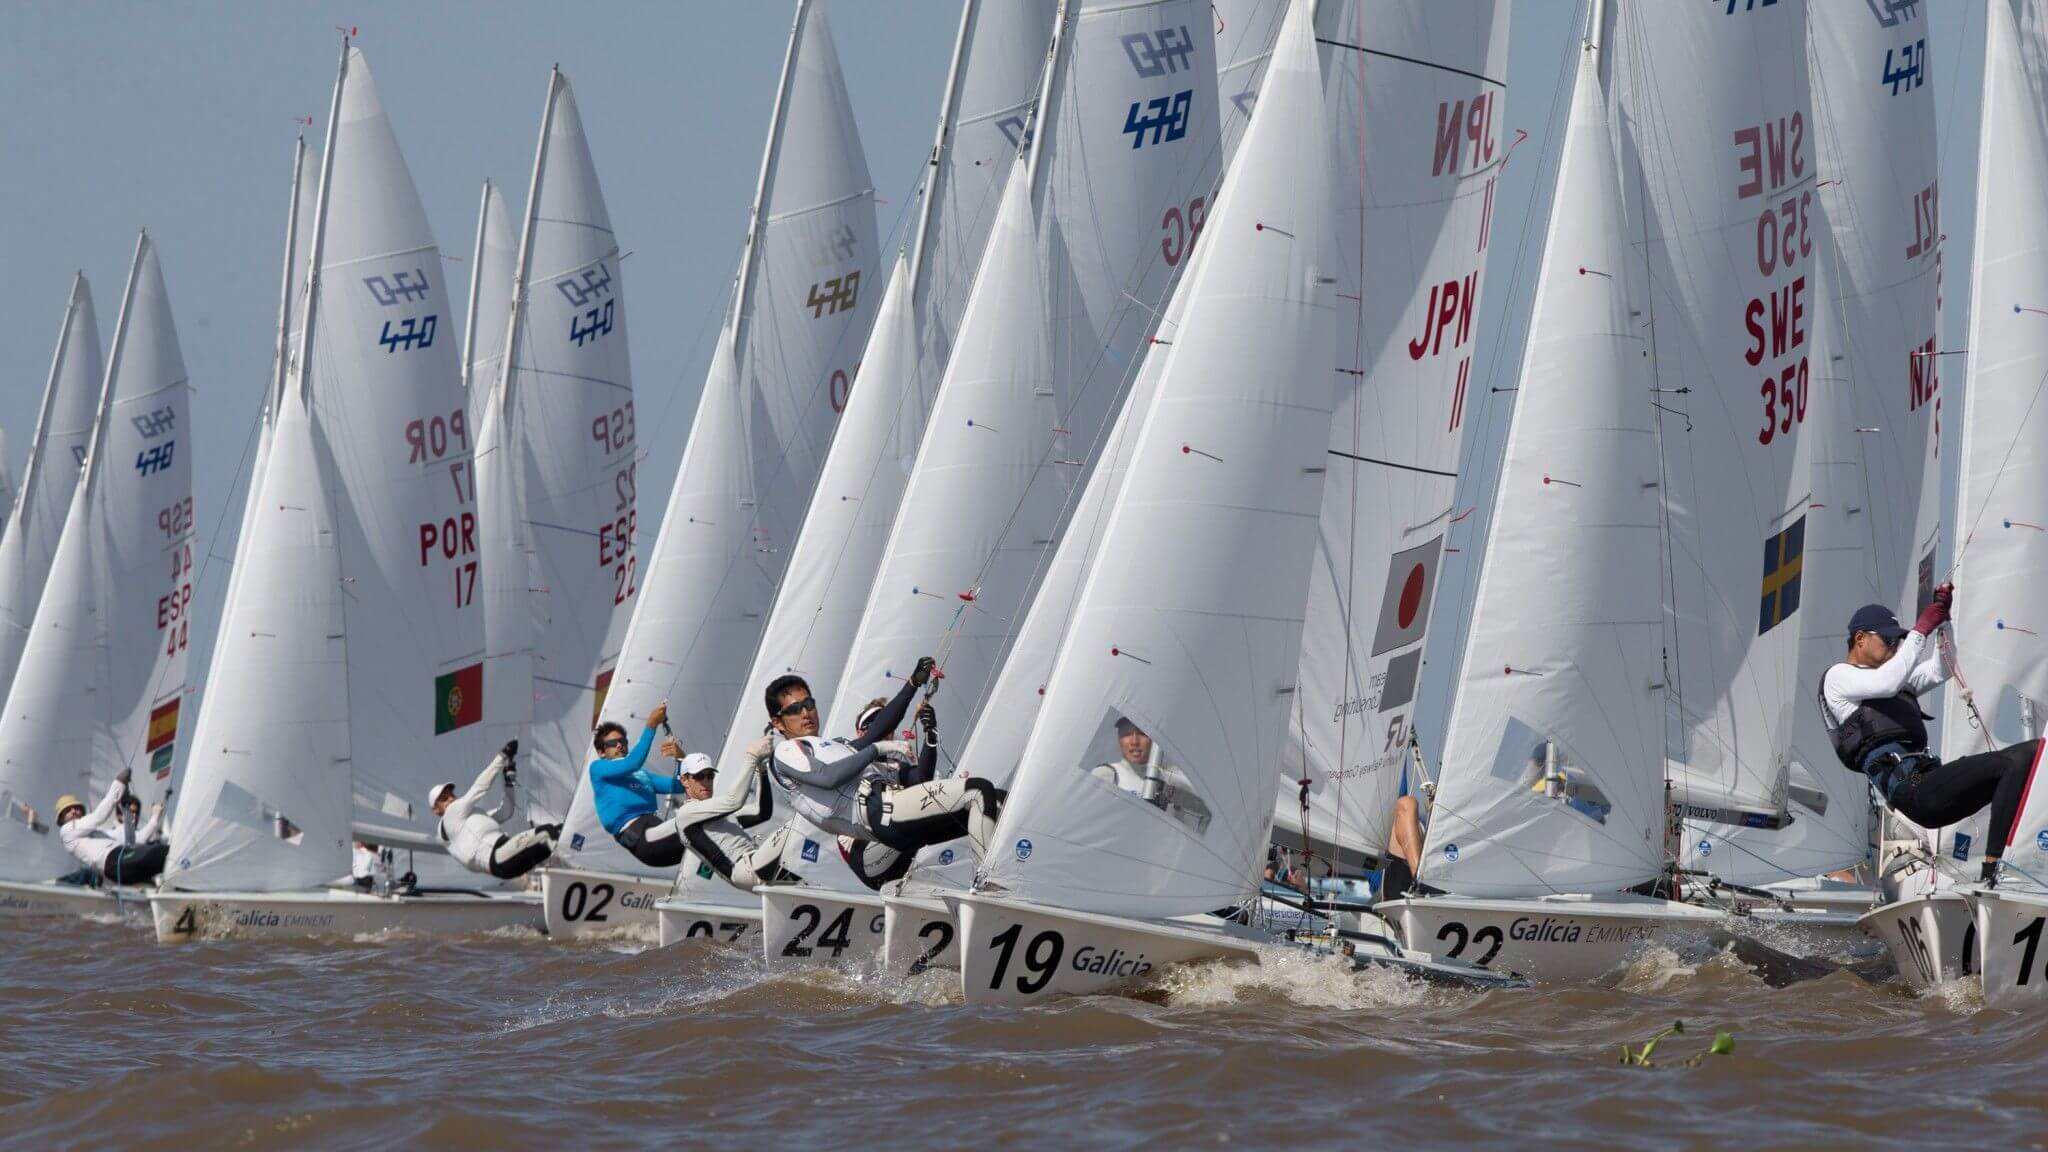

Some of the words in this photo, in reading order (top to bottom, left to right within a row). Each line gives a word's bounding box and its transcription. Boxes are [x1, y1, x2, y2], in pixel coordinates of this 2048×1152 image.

[1882, 38, 1925, 97] 470
[1122, 89, 1193, 149] 470
[806, 270, 861, 319] 470
[1408, 270, 1478, 361] JPN
[378, 314, 438, 353] 470
[570, 297, 614, 348] 470
[1745, 276, 1805, 367] SWE
[1759, 356, 1809, 445] 350
[134, 440, 175, 477] 470
[419, 512, 475, 567] POR
[600, 509, 637, 567] ESP
[157, 583, 192, 630] ESP
[455, 561, 477, 609] 17
[614, 556, 636, 606] 22
[166, 620, 188, 658] 44
[1687, 805, 1718, 820] VOLVO
[562, 882, 615, 922] 02
[781, 904, 855, 958] 24
[1436, 921, 1504, 966] 22
[1509, 917, 1581, 943] Galicia
[2013, 916, 2048, 986] 1
[989, 923, 1064, 994] 19
[1072, 946, 1152, 977] Galicia
